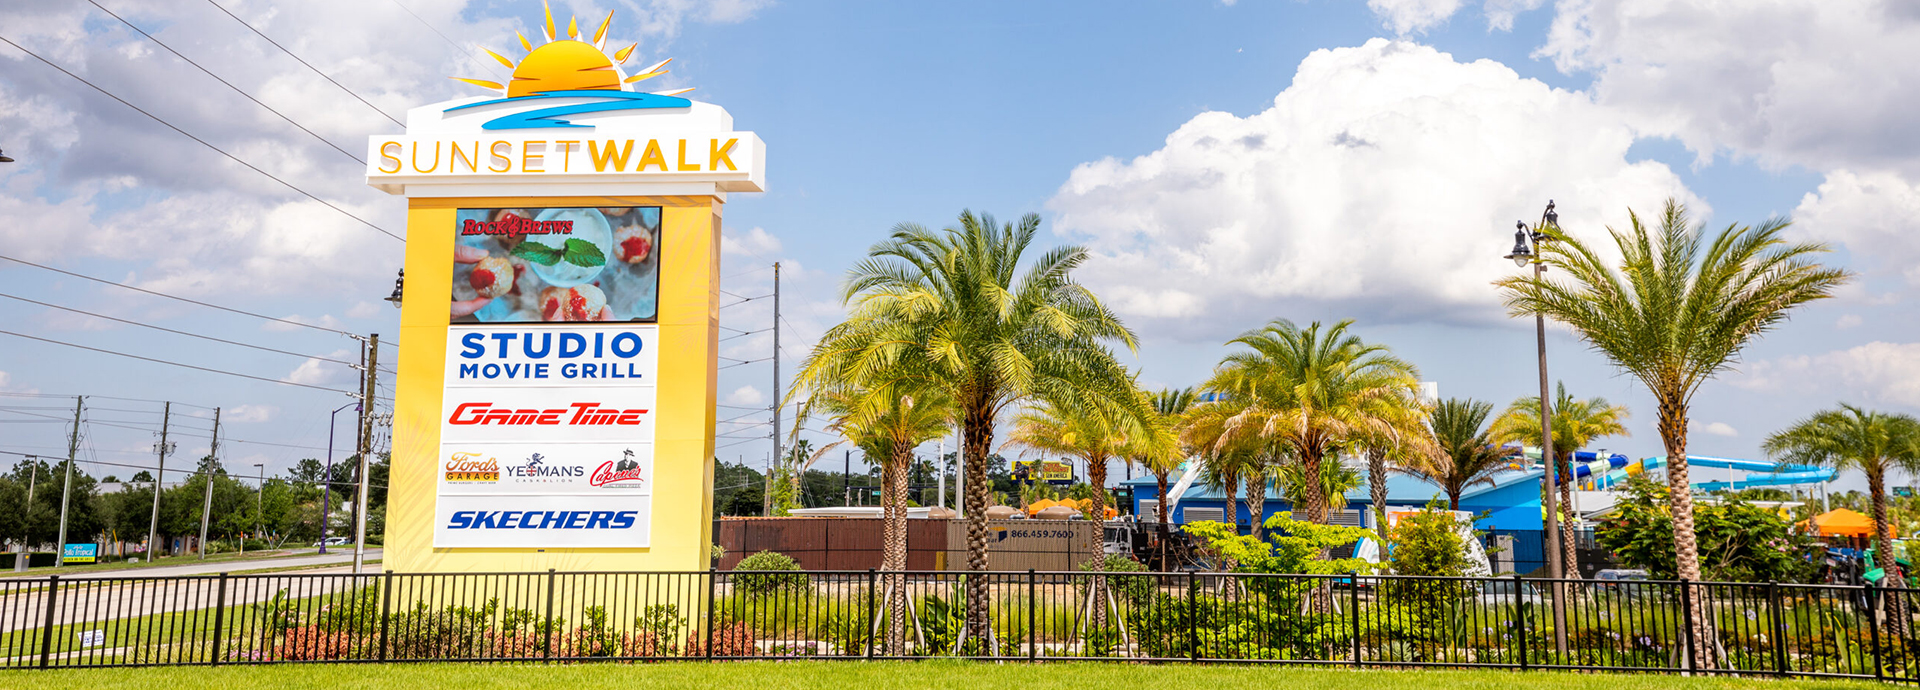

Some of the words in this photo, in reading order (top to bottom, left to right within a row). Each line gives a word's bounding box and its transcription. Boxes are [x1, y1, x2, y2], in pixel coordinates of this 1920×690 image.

[378, 138, 739, 173] SUNSETWALK
[460, 332, 643, 359] STUDIO
[459, 363, 550, 379] MOVIE
[561, 363, 642, 378] GRILL
[446, 451, 500, 471] Ford's
[446, 472, 498, 480] GARAGE
[506, 465, 584, 477] YEOMAN'S
[590, 460, 644, 487] Capone's
[447, 511, 638, 529] SKECHERS
[1011, 529, 1074, 539] 866.459.7600
